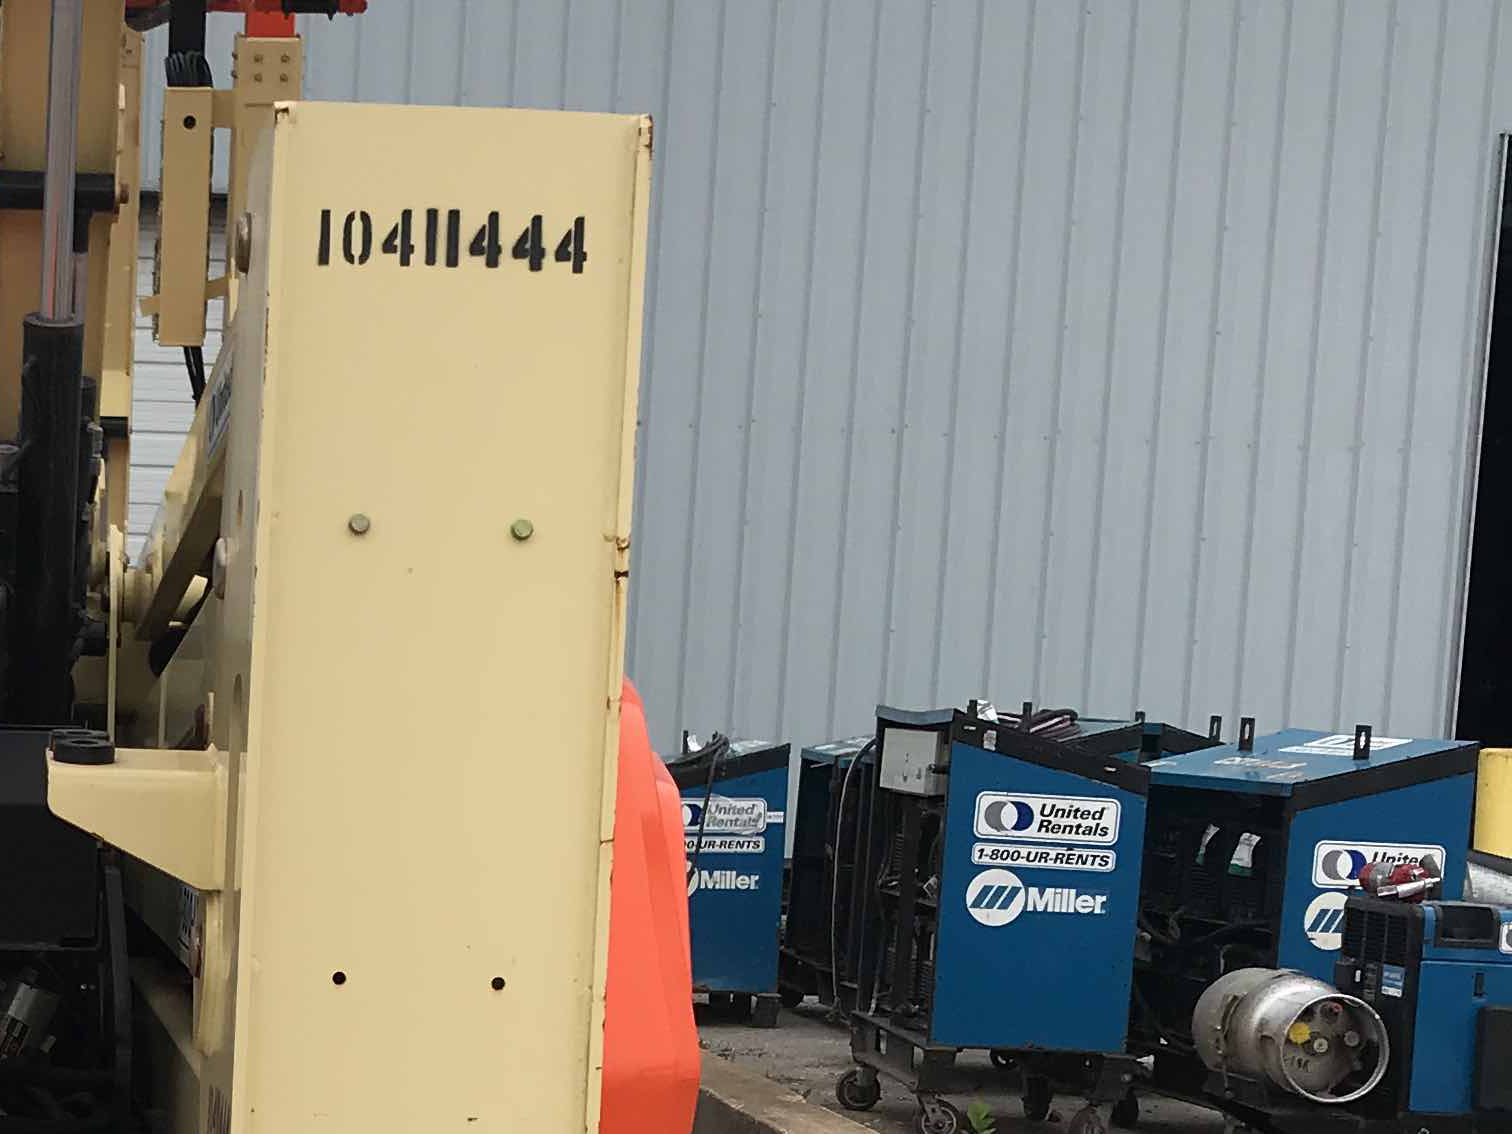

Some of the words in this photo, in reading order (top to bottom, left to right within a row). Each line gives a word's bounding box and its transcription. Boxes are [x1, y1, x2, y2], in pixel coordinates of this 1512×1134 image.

[318, 208, 588, 274] 10411444
[707, 803, 756, 815] United
[1039, 803, 1106, 821] United
[1037, 819, 1109, 837] Rentals
[977, 848, 1110, 868] 1-800-UR-RENTS
[700, 870, 760, 890] Miller
[1026, 886, 1107, 914] Miller
